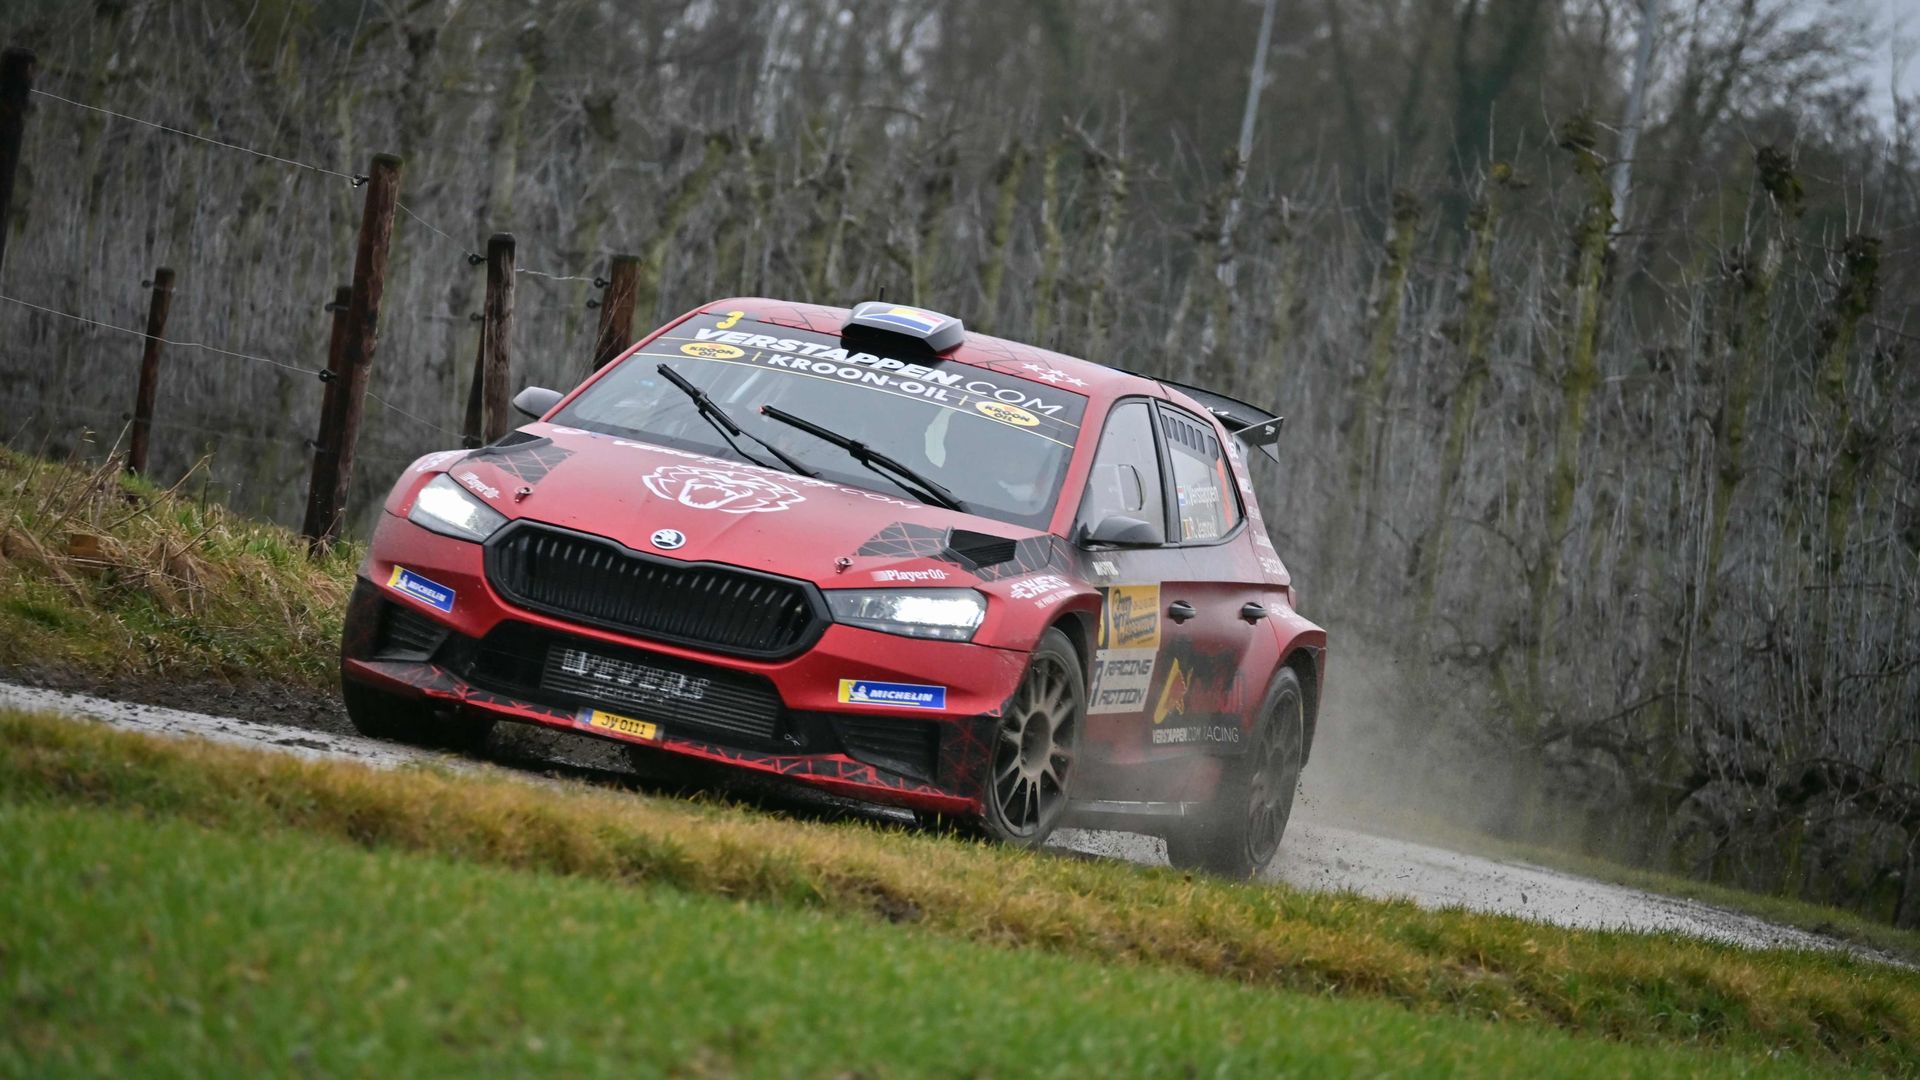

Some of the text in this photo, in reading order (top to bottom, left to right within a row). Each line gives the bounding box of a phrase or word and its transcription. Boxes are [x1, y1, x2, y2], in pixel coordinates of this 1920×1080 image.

[716, 311, 744, 329] 3
[694, 328, 1063, 415] VERSTAPPEN.COM
[767, 354, 951, 402] KROON-OIL
[985, 404, 1030, 423] KROON
[994, 412, 1013, 422] OIL
[407, 580, 447, 602] MICHELIN
[1104, 659, 1153, 676] RACING
[869, 688, 934, 702] MICHELIN
[1098, 687, 1146, 705] ACTION
